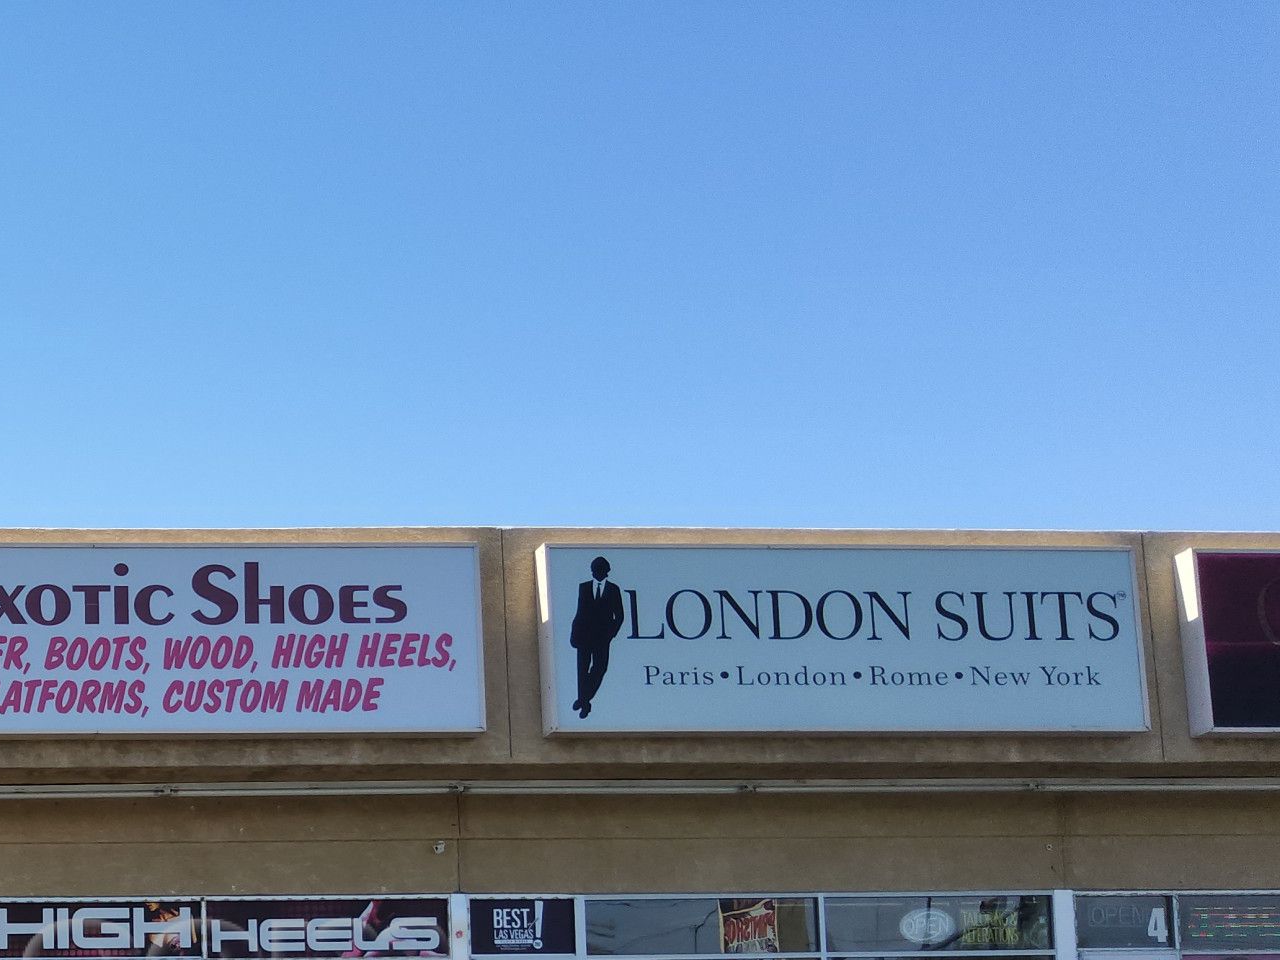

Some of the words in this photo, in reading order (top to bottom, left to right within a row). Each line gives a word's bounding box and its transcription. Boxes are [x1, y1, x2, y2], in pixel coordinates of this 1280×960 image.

[191, 562, 408, 625] Shoes
[624, 589, 913, 642] LONDON
[935, 590, 1121, 642] SUITS
[44, 634, 150, 676] BOOTS,
[163, 635, 259, 676] WOOD,
[271, 633, 346, 670] HIGH
[356, 633, 457, 673] HEELS,
[643, 665, 715, 687] Paris
[736, 665, 847, 687] London
[869, 665, 949, 688] Rome
[970, 666, 1031, 688] New
[1039, 665, 1102, 687] York
[162, 678, 289, 715] CUSTOM
[296, 677, 385, 713] MADE
[211, 916, 441, 952] HEELS
[493, 908, 530, 928] BEST
[494, 929, 508, 940] LAS
[509, 929, 534, 940] VEGAS
[1147, 907, 1169, 943] 4
